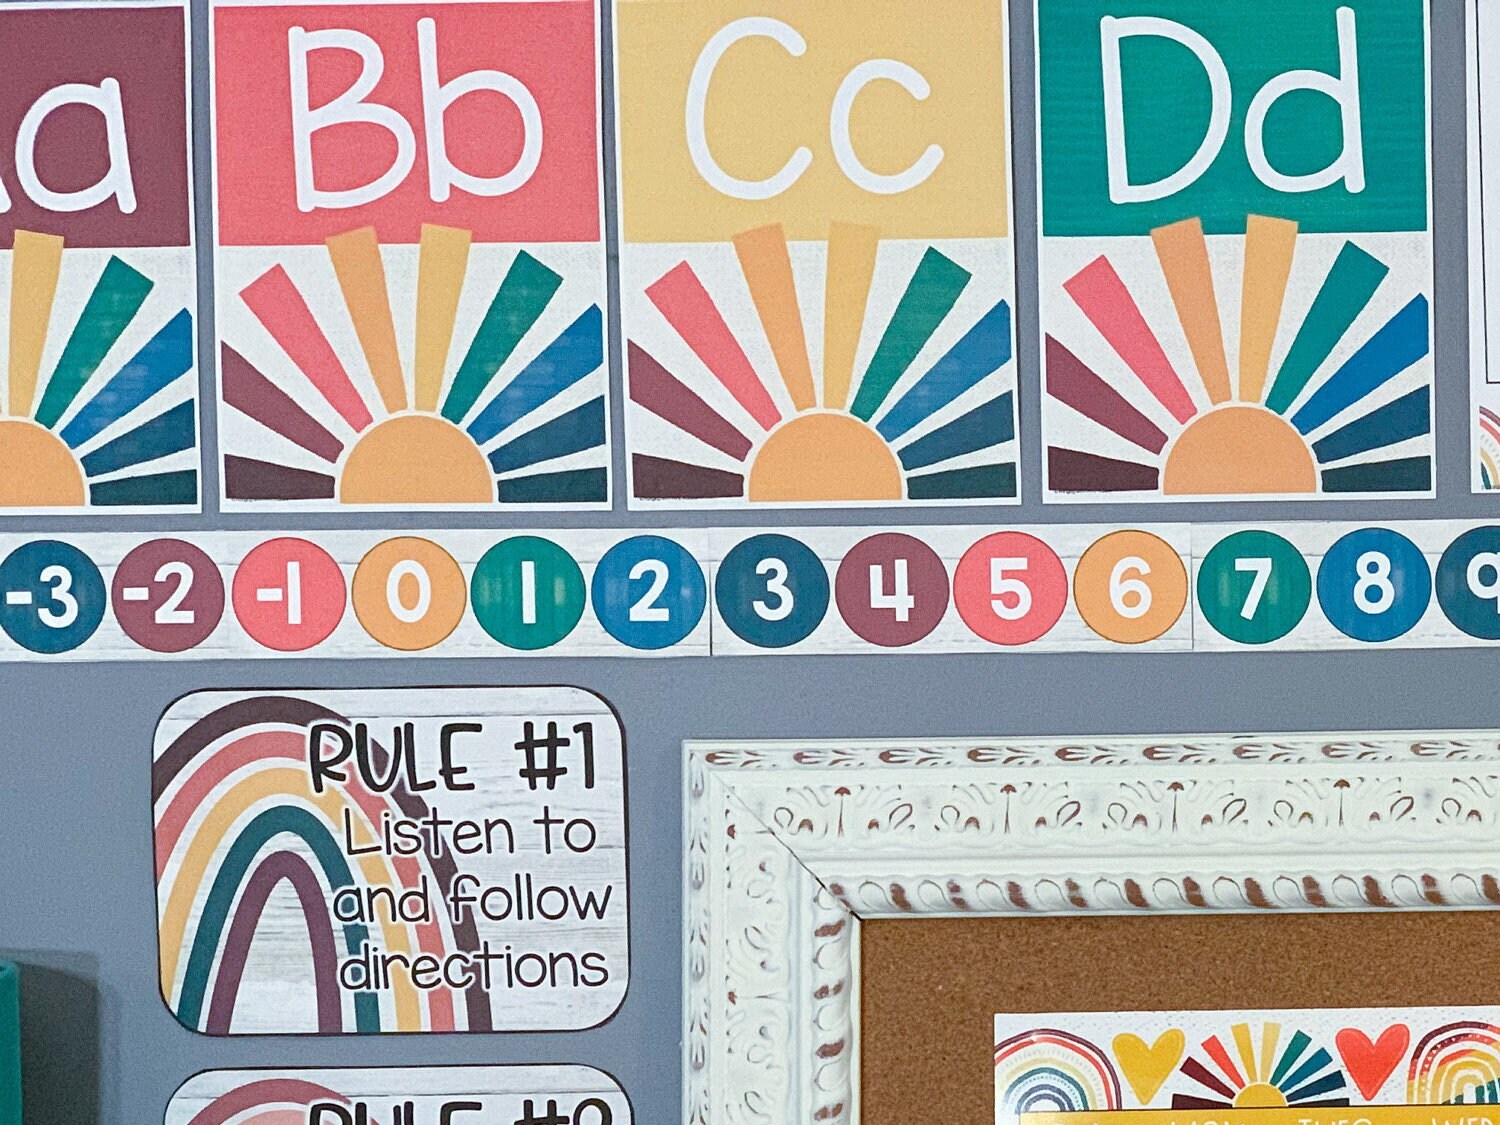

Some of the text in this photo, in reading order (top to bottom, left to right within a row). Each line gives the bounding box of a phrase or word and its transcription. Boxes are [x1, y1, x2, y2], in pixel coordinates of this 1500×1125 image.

[289, 17, 543, 213] Bb
[685, 16, 944, 201] Cc
[1101, 6, 1365, 204] Dd
[0, 77, 137, 214] a
[5, 565, 78, 629] -3
[123, 560, 194, 625] -2
[256, 561, 301, 624] -1
[387, 560, 432, 624] 0
[521, 561, 536, 624] 1
[628, 559, 670, 622] 2
[751, 558, 795, 621] 3
[869, 559, 915, 622] 4
[989, 558, 1032, 620] 5
[1108, 556, 1152, 619] 6
[1233, 557, 1273, 620] 7
[1352, 552, 1396, 616] 8
[308, 721, 595, 794] RULE #1
[345, 806, 596, 855] Listen to
[333, 873, 612, 923] and follow
[340, 942, 609, 990] directions
